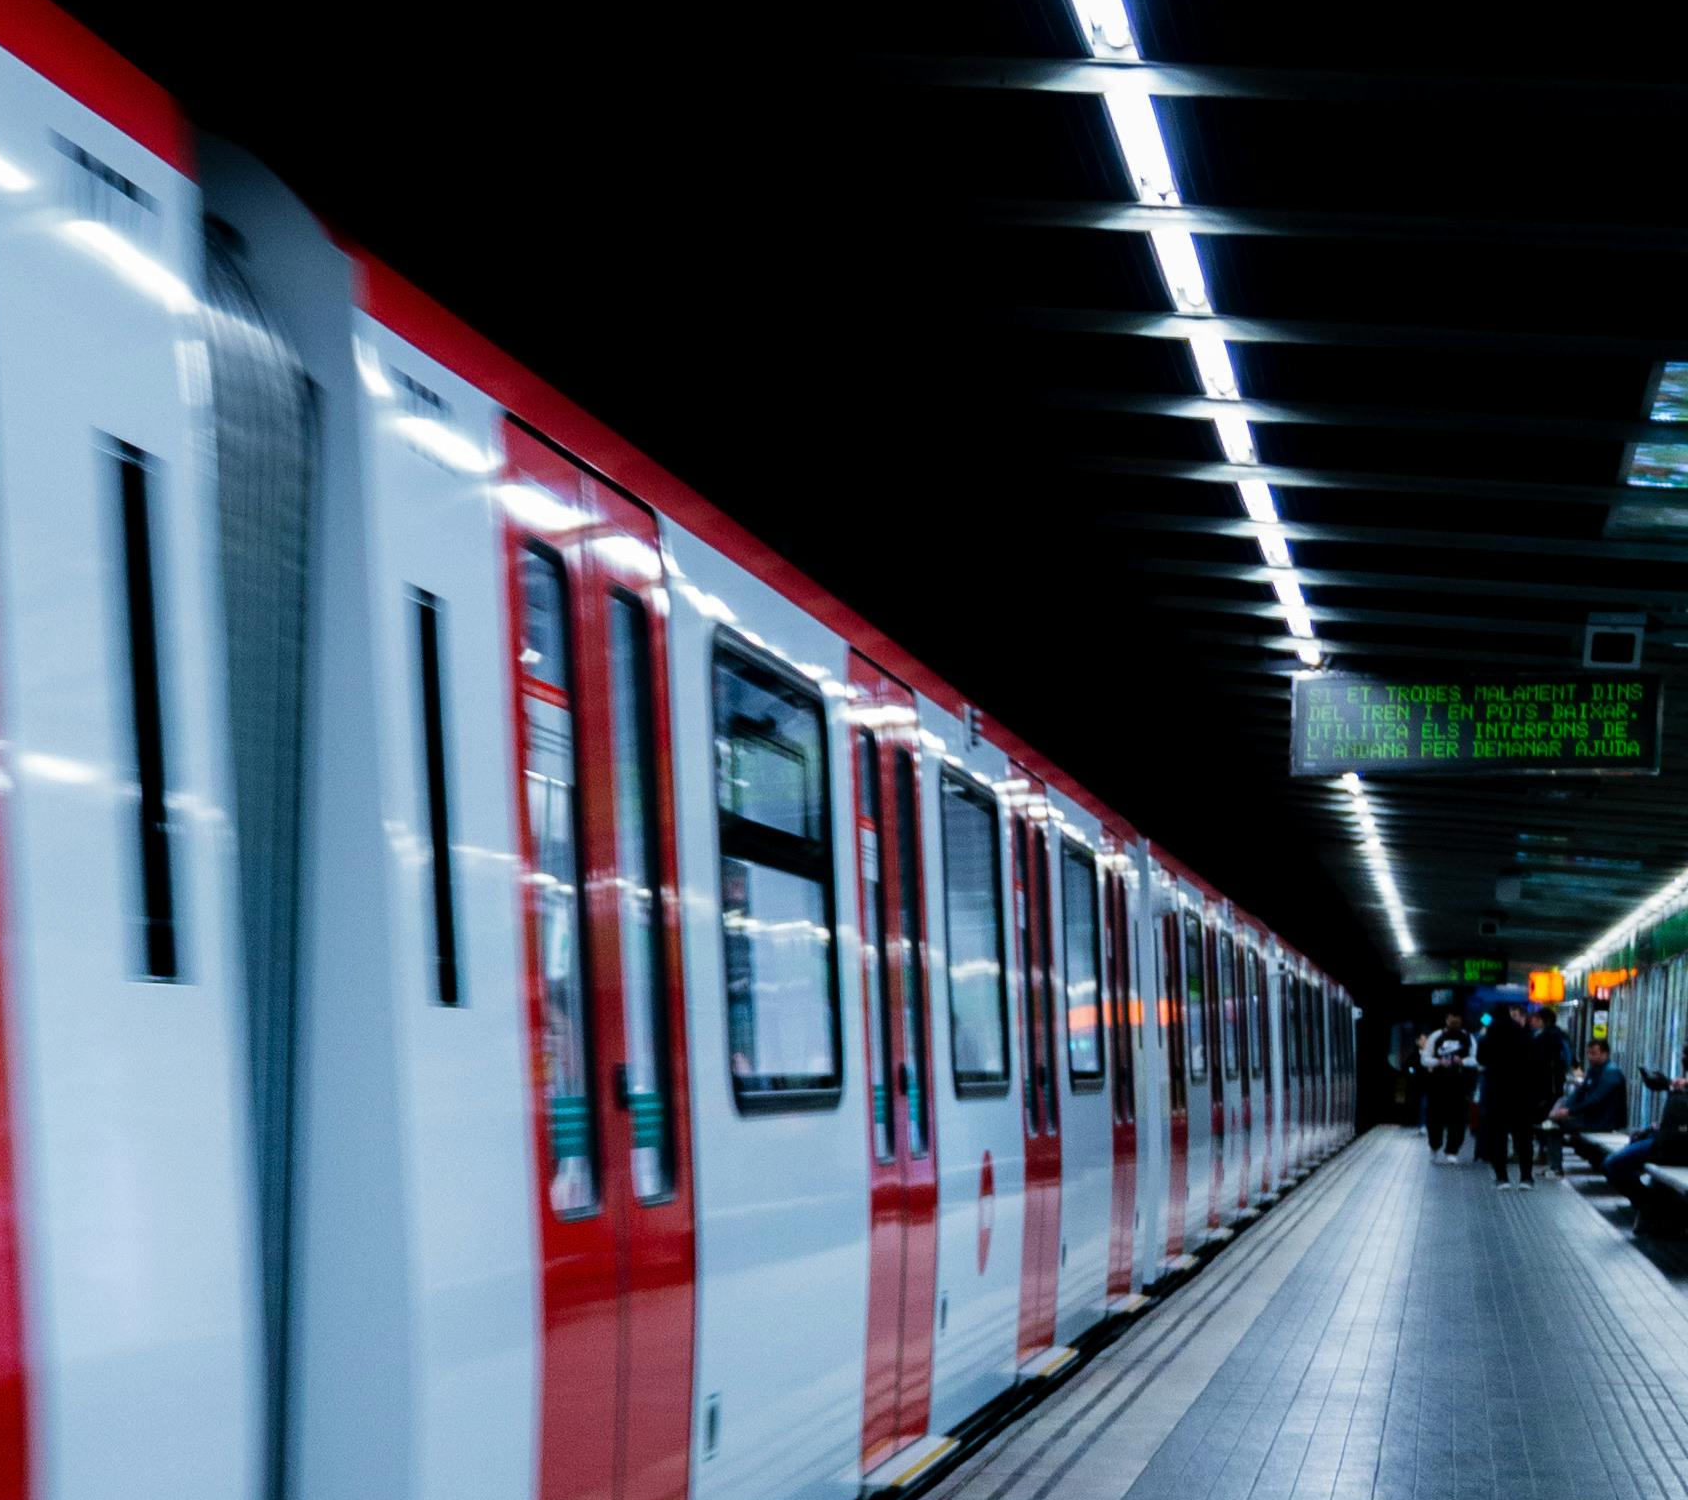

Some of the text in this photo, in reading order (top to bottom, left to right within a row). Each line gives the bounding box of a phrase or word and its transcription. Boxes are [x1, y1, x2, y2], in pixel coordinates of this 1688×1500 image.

[1347, 686, 1371, 703] ET
[1385, 685, 1461, 703] TROBES
[1474, 684, 1577, 702] MALAMENT
[1592, 683, 1643, 700] DINS
[1309, 706, 1343, 722] DEL
[1362, 704, 1410, 721] TREN
[1448, 704, 1474, 720] EN
[1486, 703, 1538, 719] POTS
[1307, 723, 1408, 740] UTILITZA
[1421, 723, 1459, 739] ELS
[1602, 721, 1628, 738] DE
[1420, 741, 1459, 757] PER
[1473, 740, 1562, 757] DEMANAR
[1575, 739, 1640, 757] AJUDA
